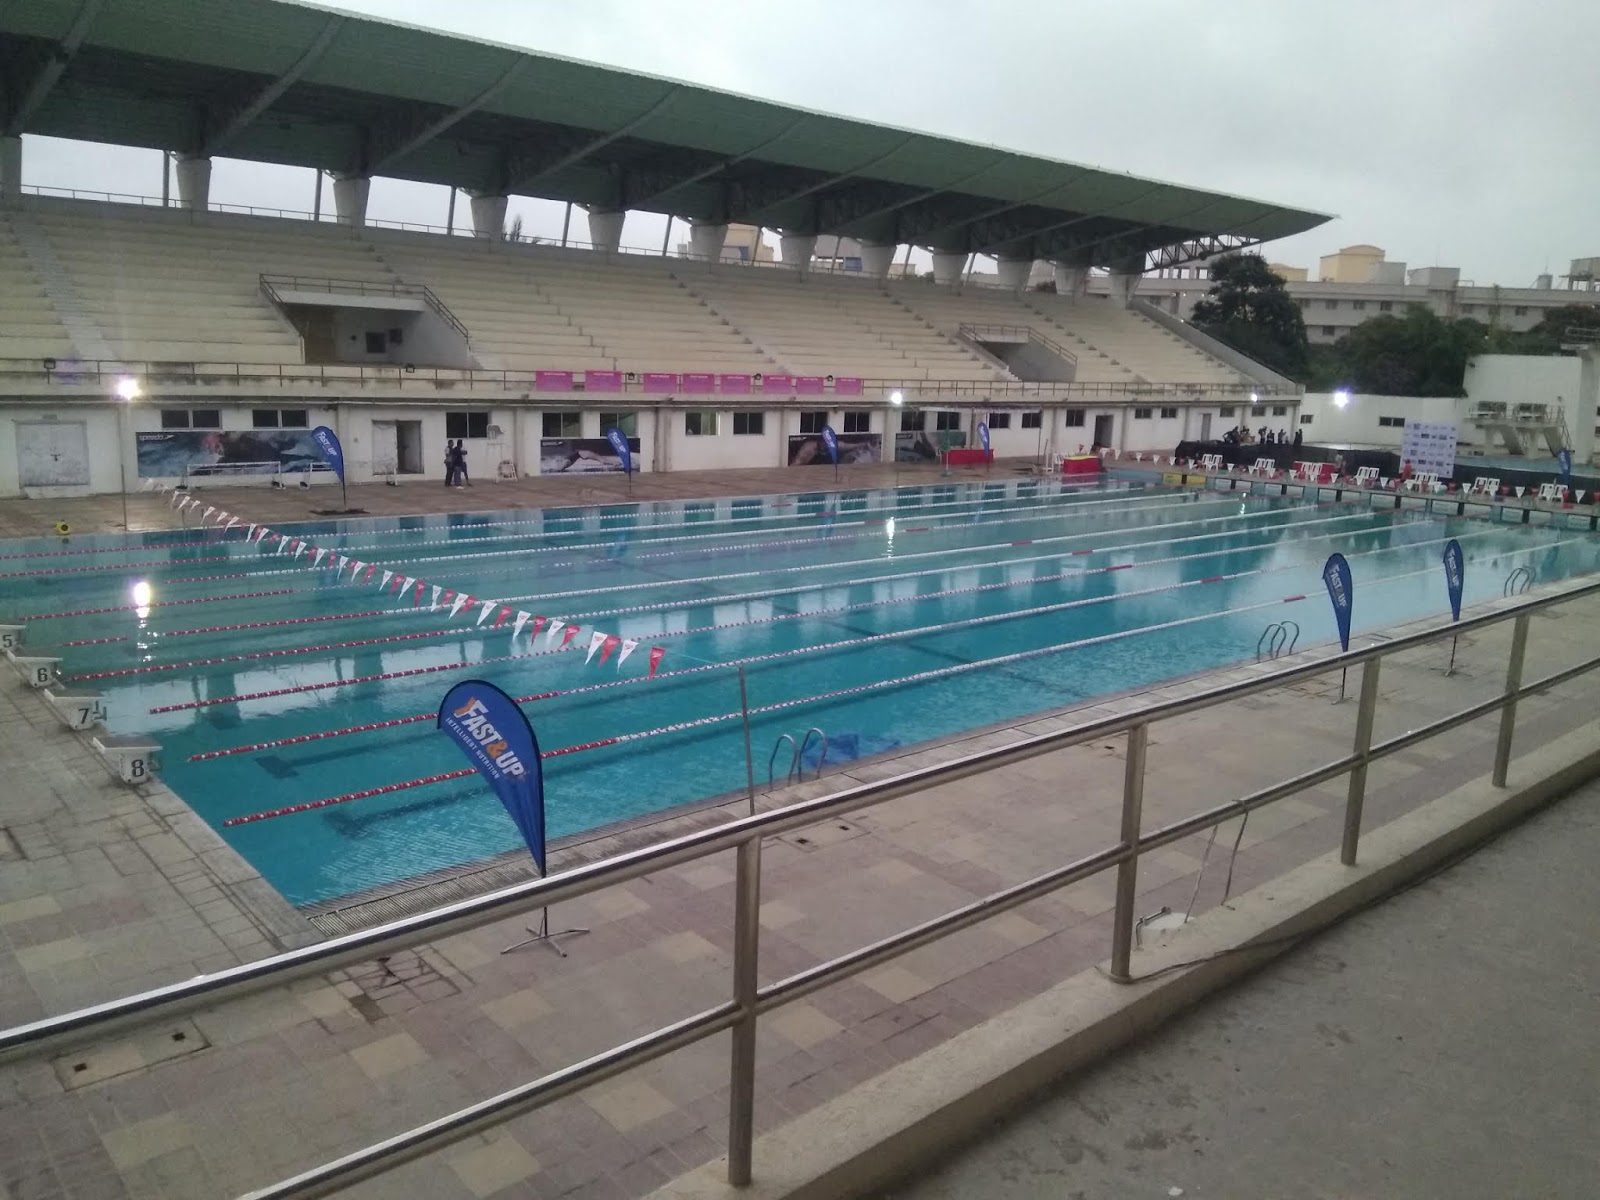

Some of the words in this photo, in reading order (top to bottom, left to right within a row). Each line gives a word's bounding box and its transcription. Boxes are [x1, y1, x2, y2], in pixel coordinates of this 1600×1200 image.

[2, 634, 13, 648] 5
[37, 668, 48, 682] 6
[78, 708, 90, 724] 7
[445, 717, 478, 750] INTELLIGENT
[475, 749, 501, 779] NUTRITION
[131, 759, 145, 777] 8
